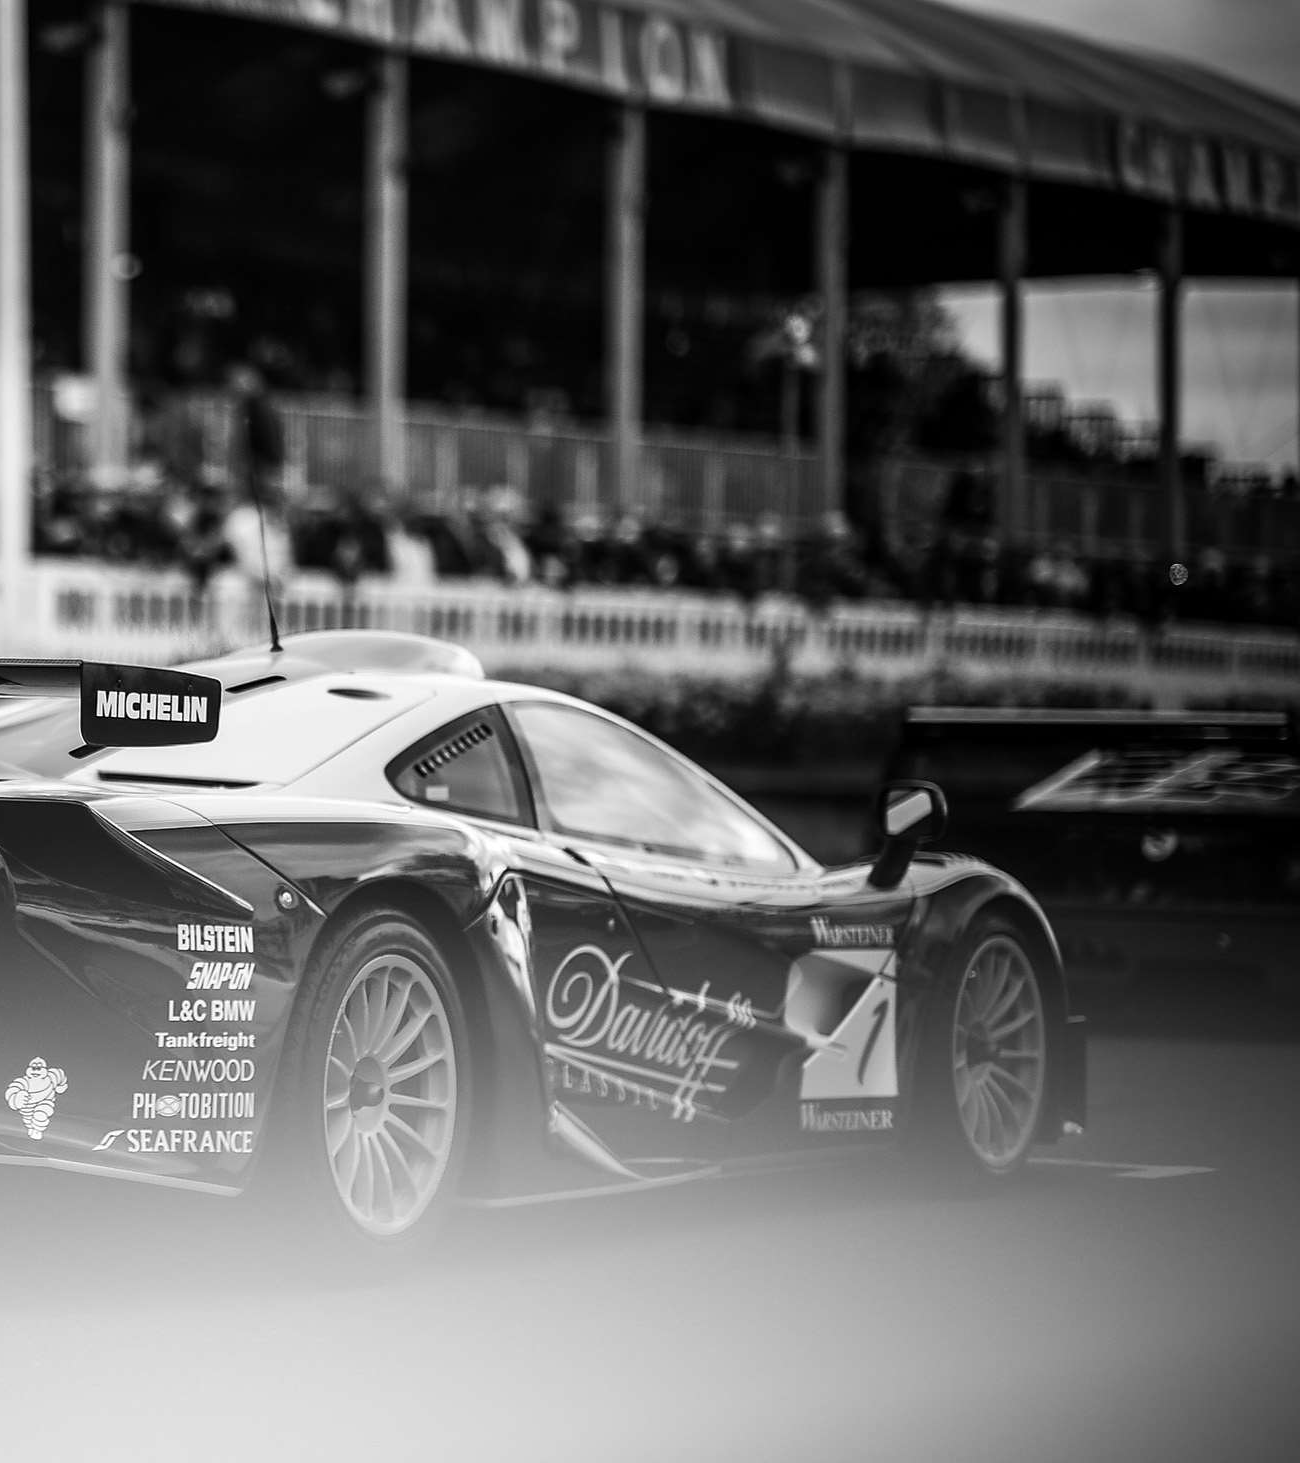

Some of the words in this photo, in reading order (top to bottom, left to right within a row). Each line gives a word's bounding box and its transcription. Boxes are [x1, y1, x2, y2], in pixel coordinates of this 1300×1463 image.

[298, 0, 732, 110] HAMPION
[95, 690, 208, 723] MICHELIN
[177, 924, 254, 952] BILSTEIN
[810, 916, 894, 945] WARSTEINER
[168, 1000, 207, 1022] L&C
[211, 1000, 256, 1022] BMW
[155, 1032, 255, 1050] Tankfreight
[857, 997, 889, 1086] 1
[142, 1059, 255, 1082] KENWOOD
[801, 1102, 894, 1131] WARSTEINER
[126, 1129, 252, 1153] SEAFRANCE
